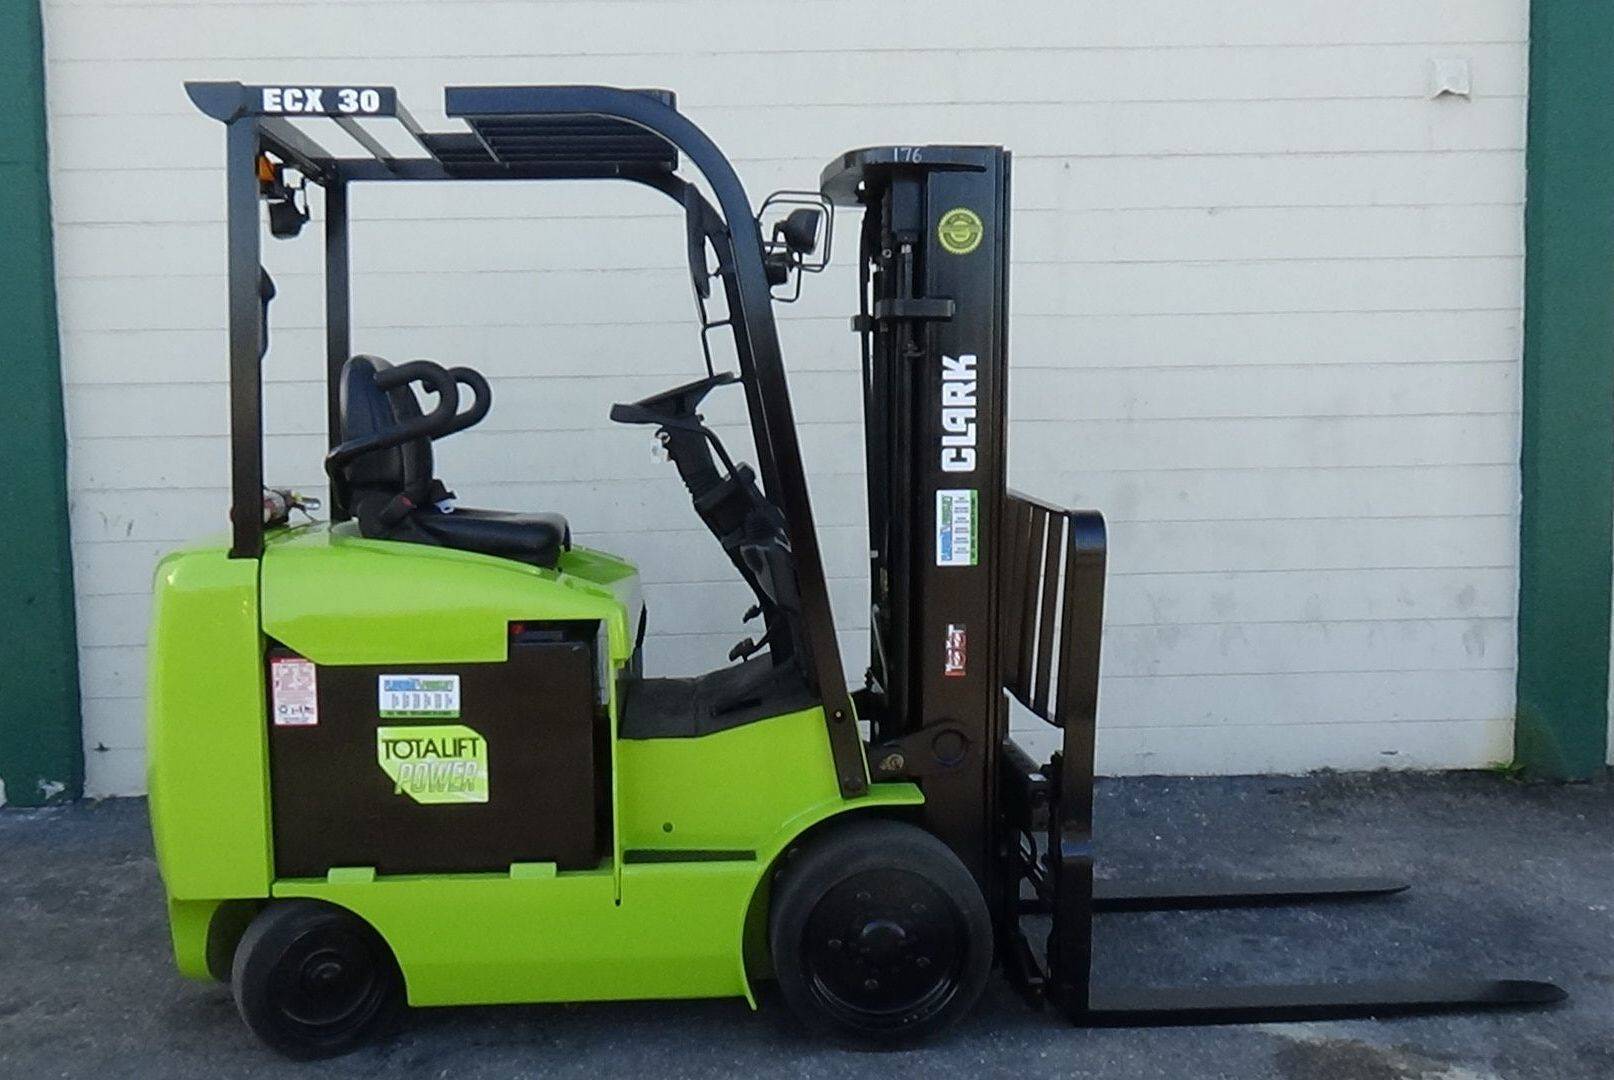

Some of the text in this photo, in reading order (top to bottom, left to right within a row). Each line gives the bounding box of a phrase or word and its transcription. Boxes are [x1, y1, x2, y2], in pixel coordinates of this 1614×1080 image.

[262, 87, 380, 113] ECX 30
[893, 147, 922, 164] 176
[941, 354, 978, 472] CLARK
[382, 737, 480, 760] TOTALIFT
[394, 761, 479, 795] POWER
